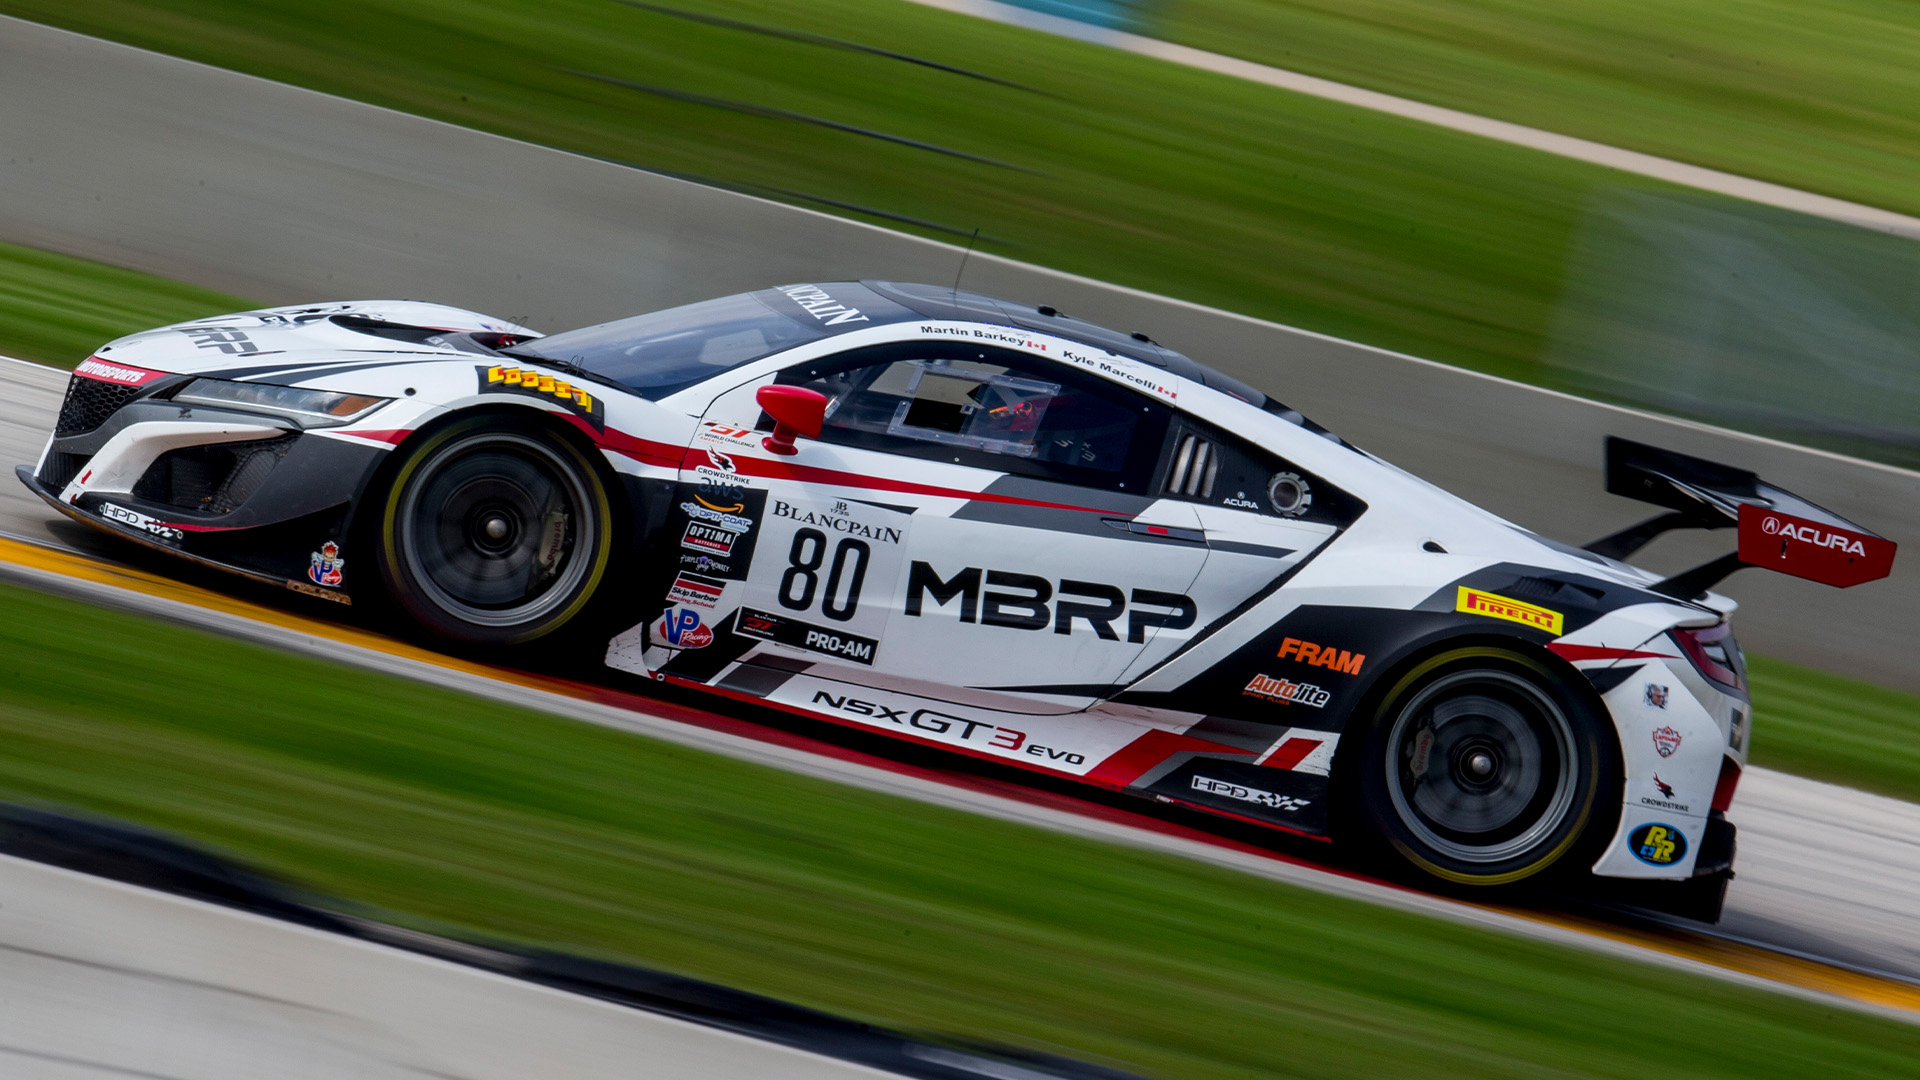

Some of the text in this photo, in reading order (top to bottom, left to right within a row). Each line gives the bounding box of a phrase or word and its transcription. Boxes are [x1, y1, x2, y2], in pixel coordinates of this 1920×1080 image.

[920, 325, 968, 337] Martin
[973, 330, 1025, 346] Barkey
[1063, 350, 1095, 367] Kyle
[1099, 362, 1157, 391] Marcelli
[704, 433, 756, 449] WORLD CHALLENGE
[697, 467, 751, 485] CROWDSTRIKE
[698, 477, 745, 501] aws
[104, 505, 139, 524] HPD
[1223, 497, 1259, 510] ACURA
[699, 510, 749, 527] OPTI-COAT
[772, 500, 903, 545] BLANCPAIN
[547, 521, 563, 561] brembo
[689, 525, 733, 544] OPTIMA
[1778, 523, 1866, 557] ACURA
[778, 527, 871, 622] 80
[668, 594, 715, 609] Racing School
[671, 586, 718, 603] Skip Barber
[904, 560, 1198, 644] MBRP
[1466, 592, 1555, 629] PIRELLI
[665, 608, 700, 646] VP
[682, 632, 712, 644] Racing
[805, 630, 872, 660] PRO-AM
[1277, 636, 1366, 676] FRAM
[1244, 673, 1331, 708] Autolite
[811, 690, 909, 725] NSX
[1026, 744, 1085, 766] EVO
[1193, 777, 1249, 798] HPD
[1641, 797, 1689, 812] CROWDSTRIKE
